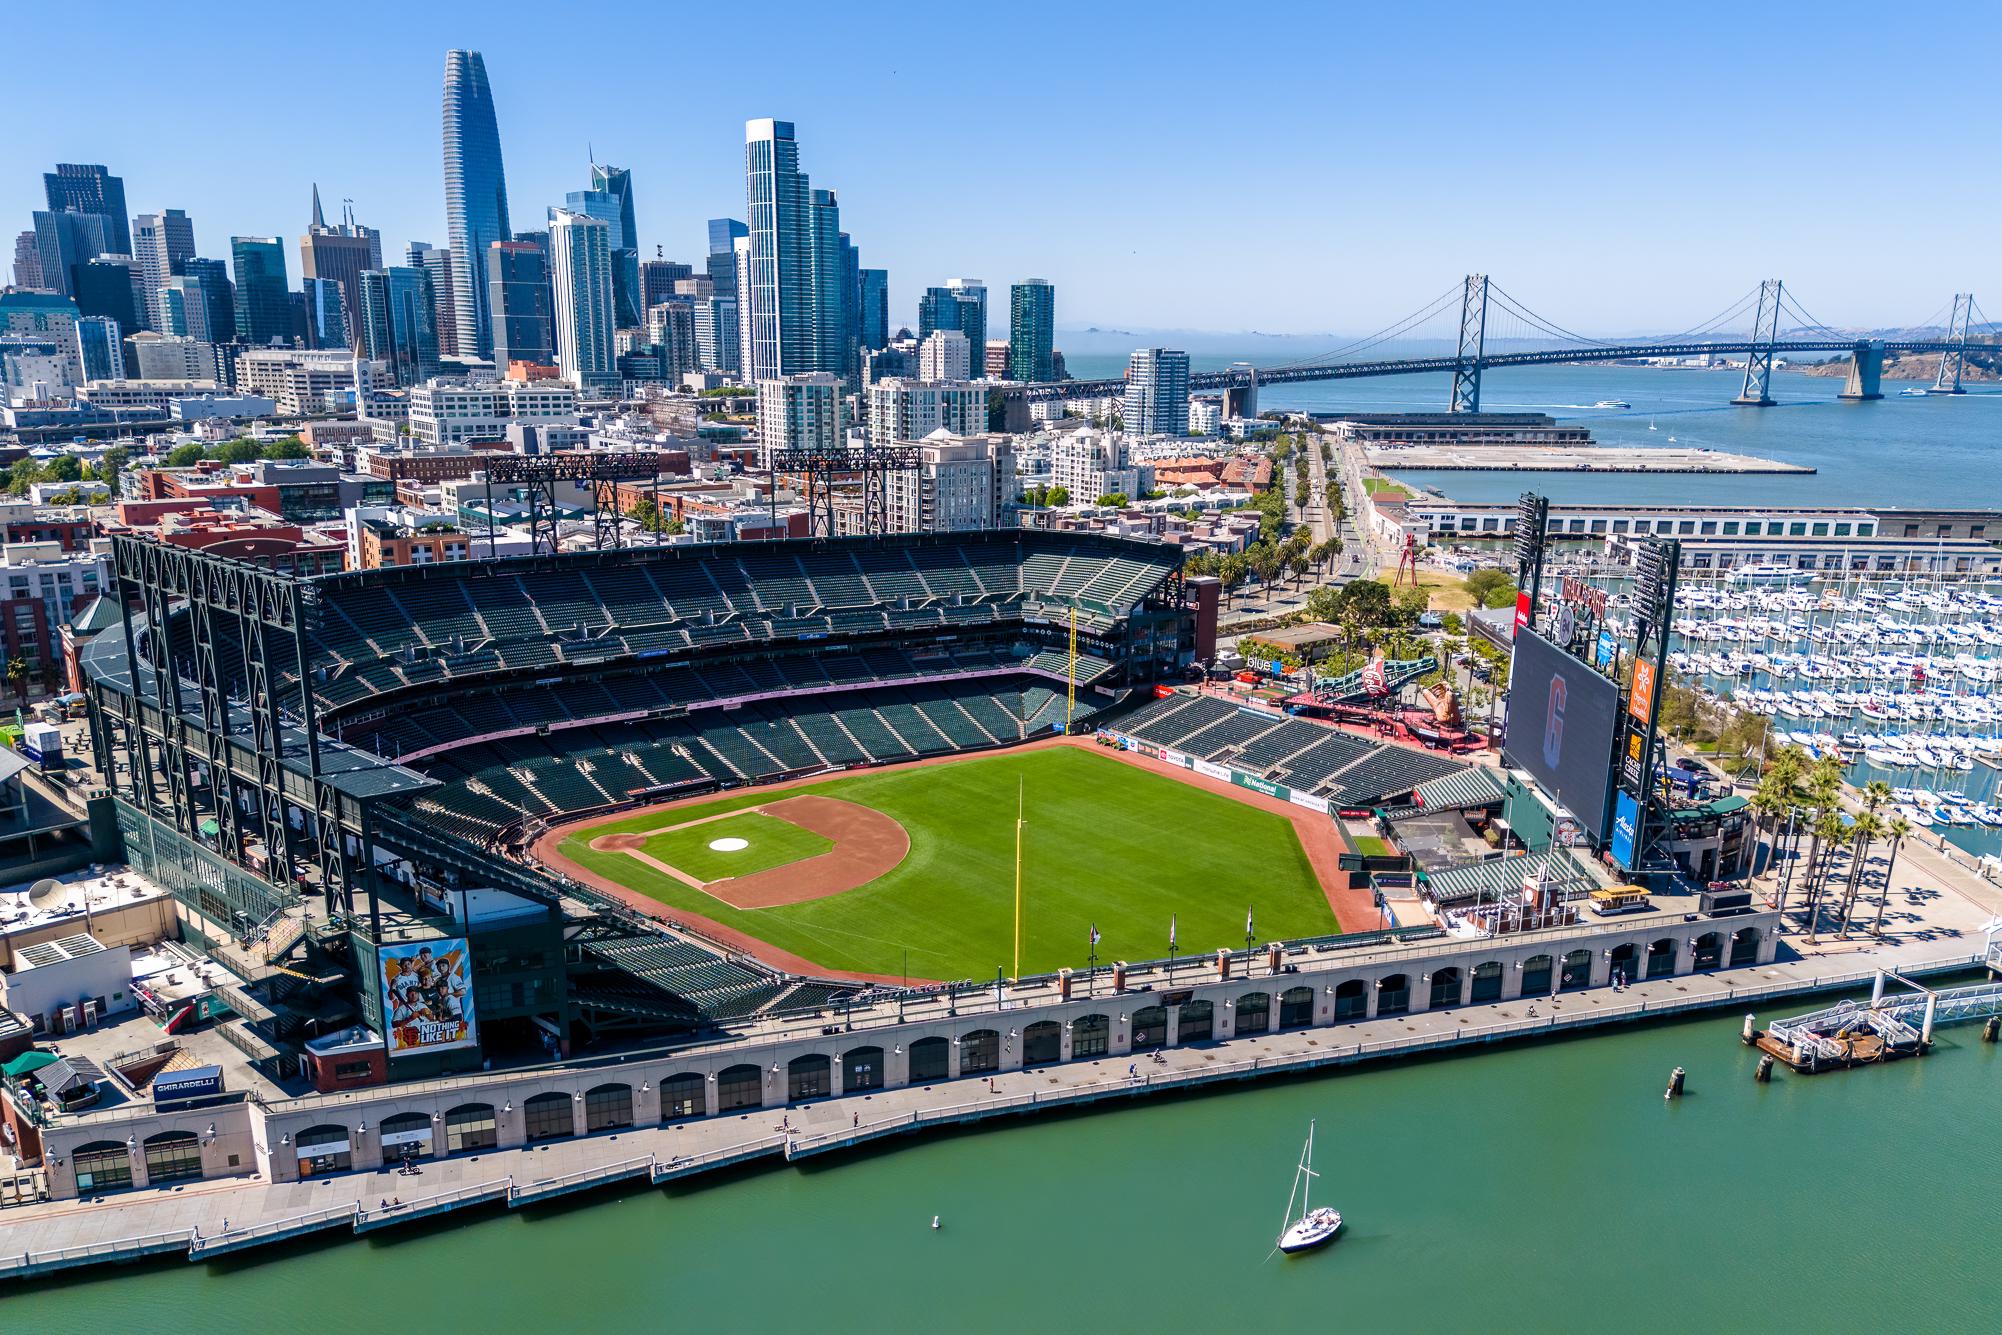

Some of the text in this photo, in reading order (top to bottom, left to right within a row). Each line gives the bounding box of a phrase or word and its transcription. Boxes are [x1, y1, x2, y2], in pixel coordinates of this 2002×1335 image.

[1248, 655, 1271, 671] blue
[1624, 763, 1639, 779] CREEK
[1625, 755, 1640, 772] CACHE
[1252, 780, 1277, 793] National
[1616, 816, 1634, 836] Alaska
[421, 1020, 460, 1035] NOTHING
[421, 1031, 443, 1043] LIKE
[446, 1028, 460, 1040] IT
[157, 1079, 214, 1092] GHIRARDELLI
